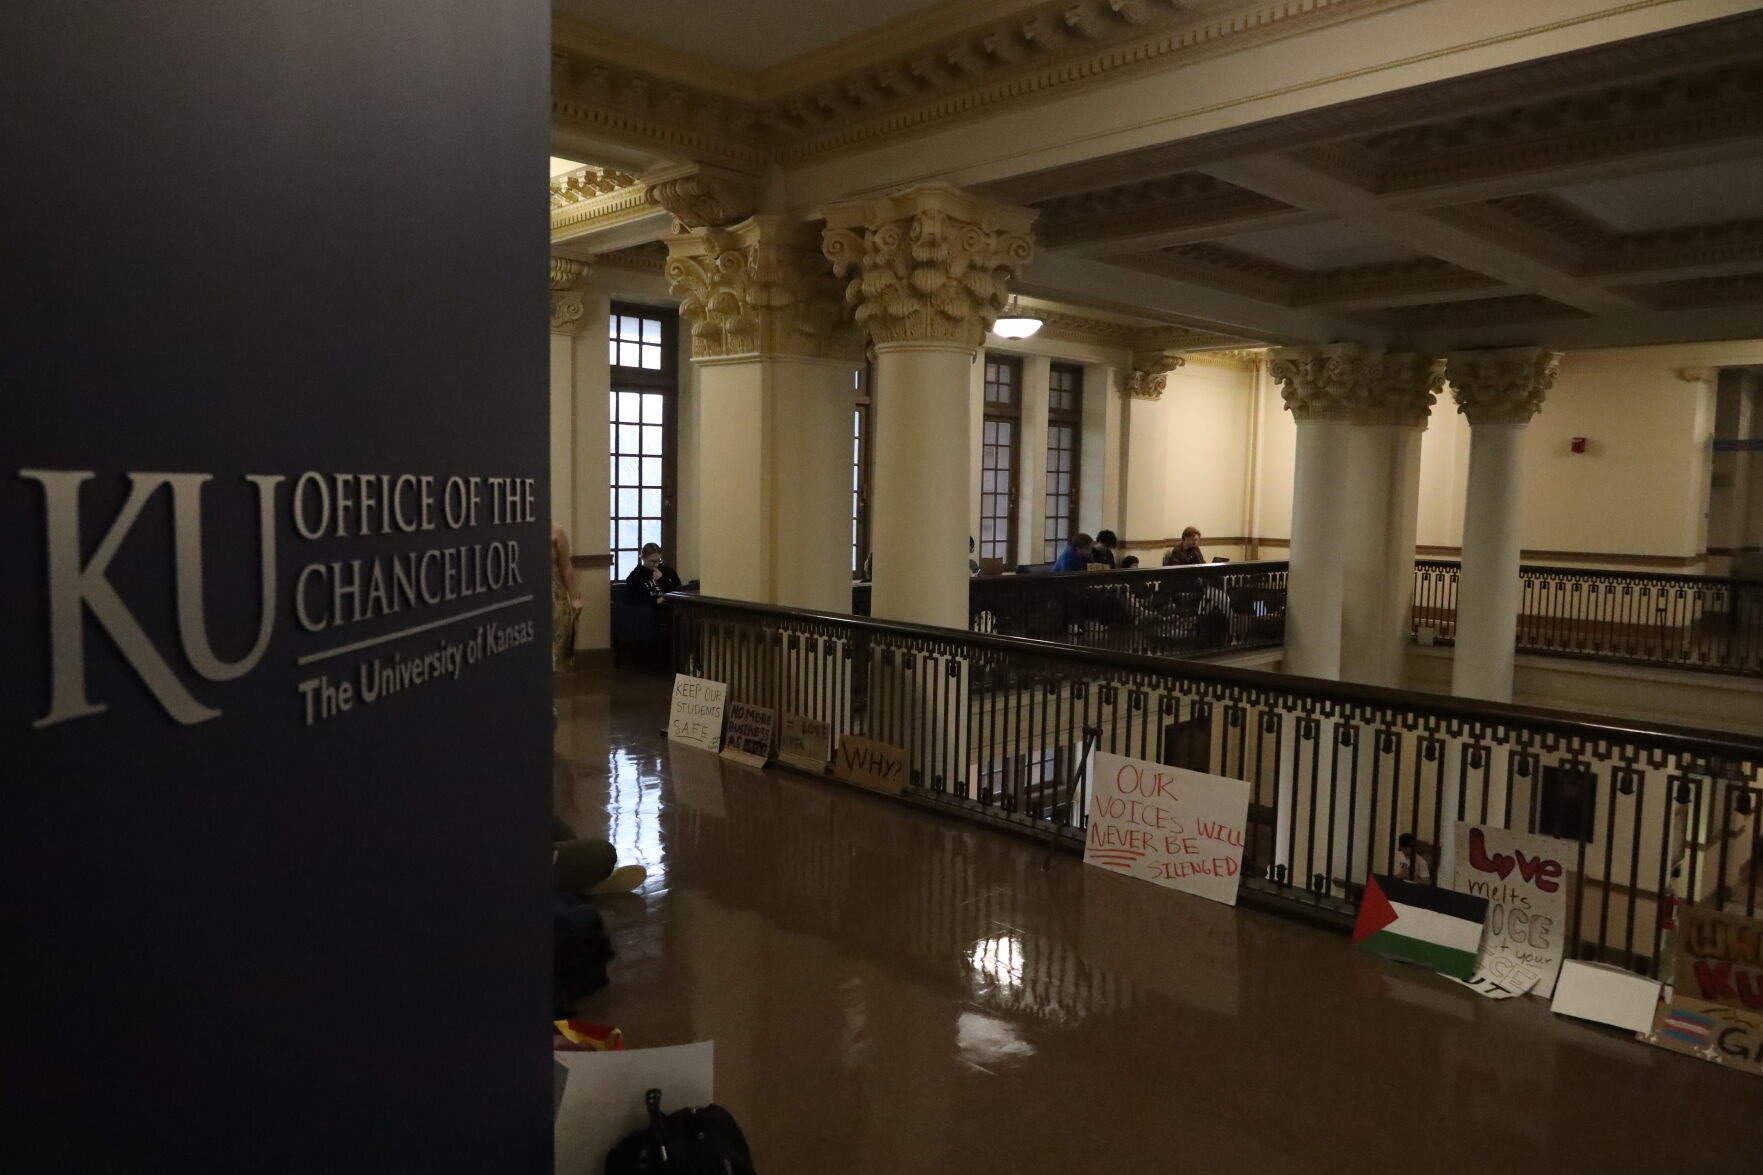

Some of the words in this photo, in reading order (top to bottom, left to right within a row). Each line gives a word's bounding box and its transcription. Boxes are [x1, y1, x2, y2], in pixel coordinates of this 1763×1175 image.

[18, 468, 286, 728] KU
[293, 471, 435, 540] OFFICE
[444, 475, 485, 529] OF
[487, 477, 535, 525] THE
[295, 540, 524, 632] CHANCELLOR
[299, 676, 353, 726] The
[360, 642, 463, 702] University
[467, 632, 488, 663] of
[487, 618, 535, 654] Kansas
[675, 681, 702, 698] KEEP
[704, 687, 721, 702] OUR
[676, 701, 721, 718] STUDENTS
[731, 704, 745, 719] NO
[745, 708, 773, 726] MORE
[673, 719, 709, 739] SAFE
[729, 721, 769, 740] BUSINESS
[840, 739, 902, 781] WHY?
[1117, 764, 1178, 801] OUR
[1095, 795, 1184, 834] VOICES
[1196, 817, 1248, 848] WILL
[1091, 822, 1158, 852] NEVER
[1164, 835, 1200, 855] BE
[1468, 879, 1531, 910] melts
[1515, 951, 1553, 964] your
